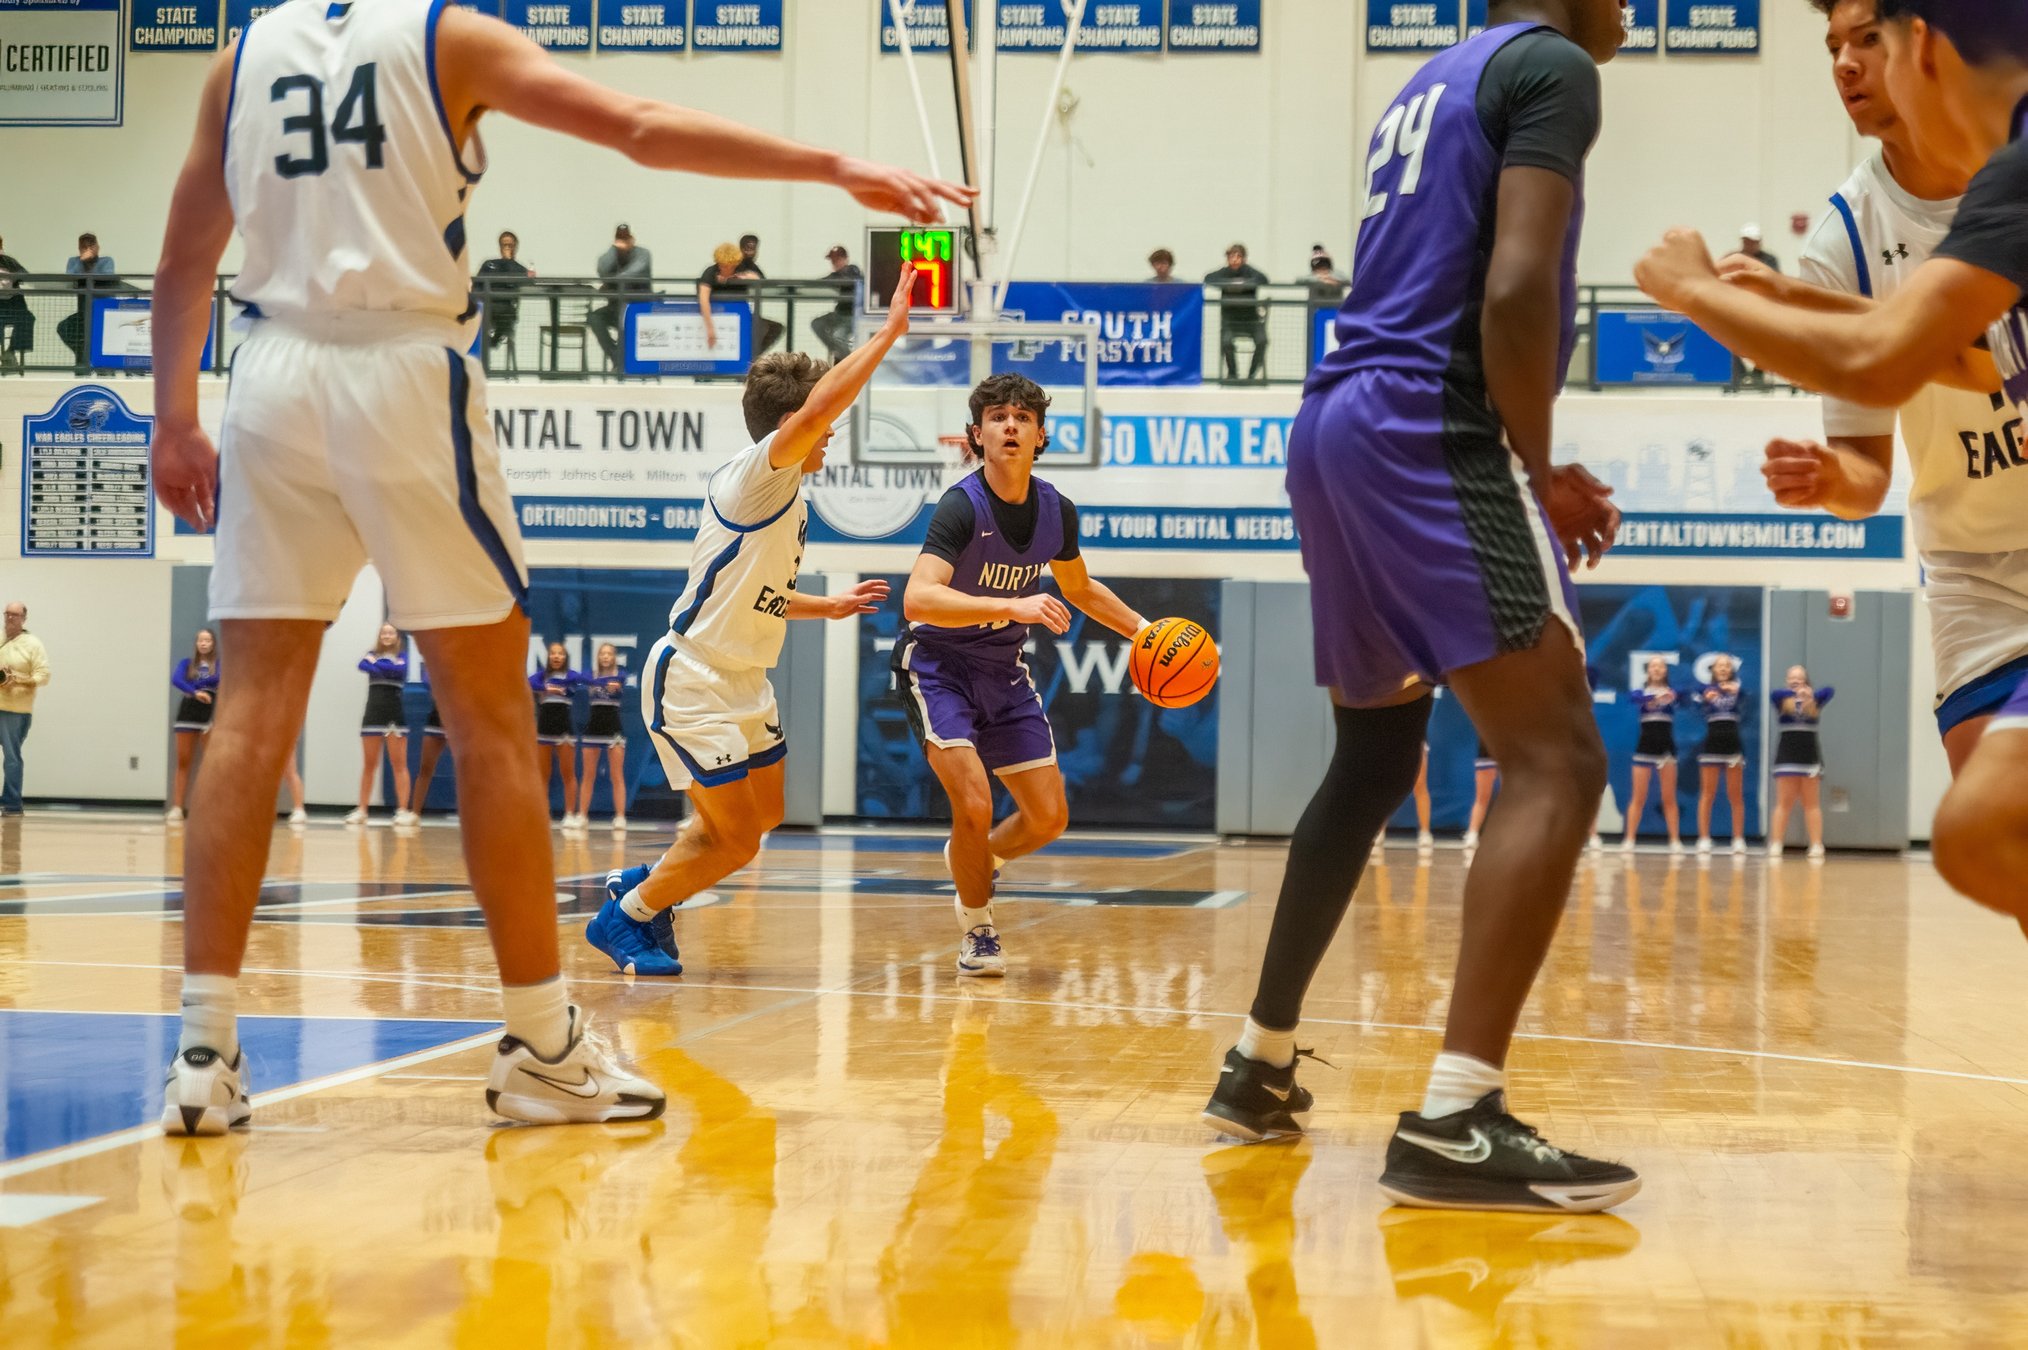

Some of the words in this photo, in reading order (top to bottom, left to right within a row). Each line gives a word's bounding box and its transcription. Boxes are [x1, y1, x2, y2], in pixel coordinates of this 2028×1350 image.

[156, 7, 197, 24] STATE
[527, 6, 570, 25] STATE
[622, 6, 665, 26] STATE
[716, 6, 760, 26] STATE
[1001, 6, 1045, 26] STATE
[1096, 5, 1140, 26] STATE
[1192, 5, 1238, 26] STATE
[1391, 4, 1437, 25] STATE
[135, 27, 215, 45] CHAMPIONS
[517, 26, 589, 46] AMPIONS
[600, 26, 684, 46] CHAMPIONS
[695, 26, 779, 46] CHAMPIONS
[883, 27, 969, 46] CAMPIO
[997, 27, 1065, 46] AMPIONS
[1170, 25, 1258, 46] CHAMPIONS
[1369, 25, 1457, 47] CHAMPIONS
[7, 45, 110, 72] CERTIFIED
[270, 62, 387, 178] 34
[1362, 82, 1447, 221] 24
[910, 258, 945, 309] 7
[494, 409, 582, 450] NTAL
[597, 410, 705, 451] TOWN
[1147, 418, 1231, 465] WAR
[506, 468, 549, 481] Forsyth
[600, 469, 635, 481] Creek
[647, 470, 687, 481] Milton
[884, 465, 942, 490] TOWN
[522, 504, 647, 528] ORTHODONTICS
[664, 507, 703, 530] ORA
[1081, 513, 1106, 538] OF
[1108, 514, 1157, 539] YOUR
[1161, 515, 1232, 540] DENTAL
[1235, 515, 1294, 540] NEEDS
[1159, 624, 1202, 667] Wilson
